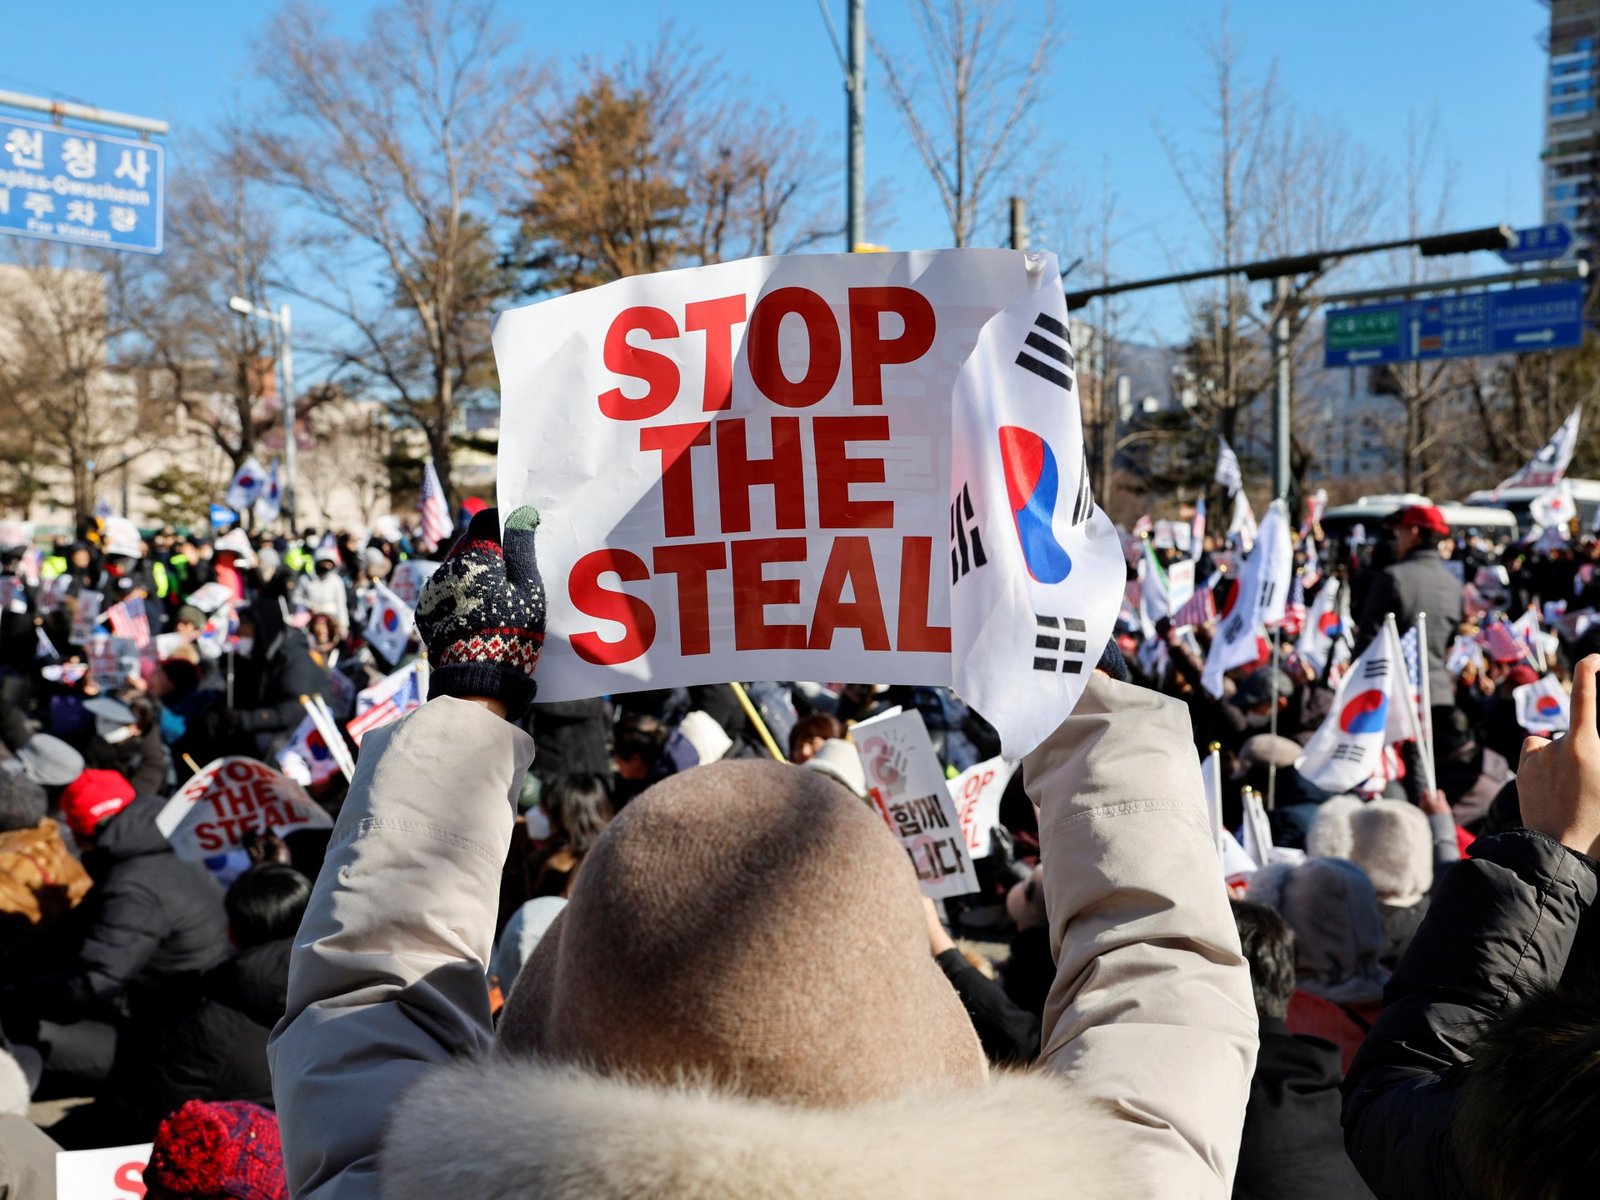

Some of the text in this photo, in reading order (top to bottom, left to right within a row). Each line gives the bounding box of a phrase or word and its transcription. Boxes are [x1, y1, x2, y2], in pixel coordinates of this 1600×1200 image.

[598, 286, 936, 421] STOP
[640, 416, 894, 538] THE
[568, 536, 952, 666] STEAL
[207, 778, 279, 818] THE
[963, 770, 994, 799] OP
[194, 799, 309, 851] STEAL
[889, 794, 949, 837] 함께
